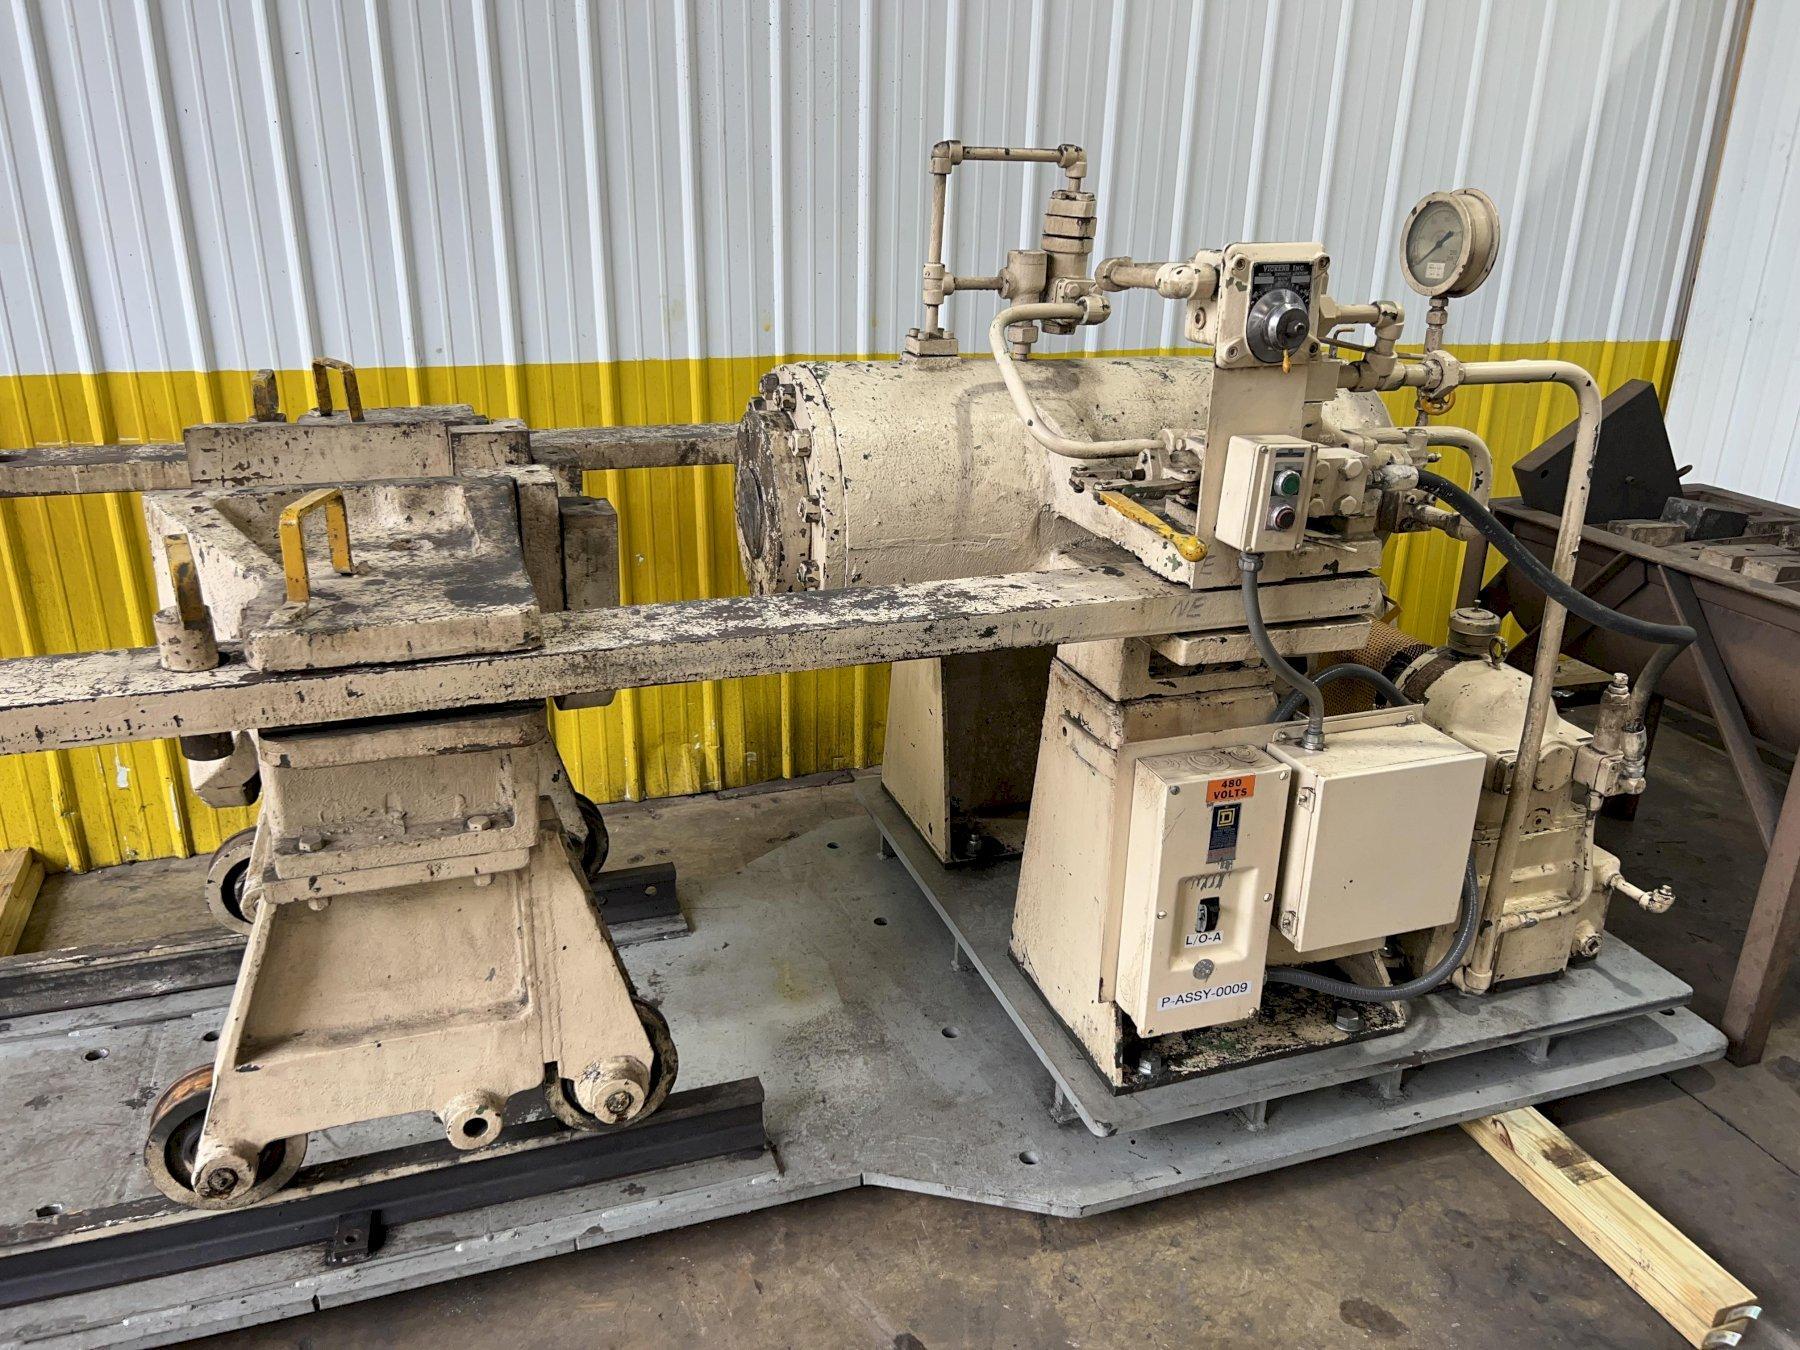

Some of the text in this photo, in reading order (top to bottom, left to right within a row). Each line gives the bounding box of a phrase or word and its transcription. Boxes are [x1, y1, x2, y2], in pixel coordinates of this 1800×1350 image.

[1221, 778, 1242, 789] 480
[1213, 788, 1247, 800] VOLTS
[1186, 932, 1221, 946] L/O-A
[1161, 982, 1248, 1008] P-ASSY-0009
